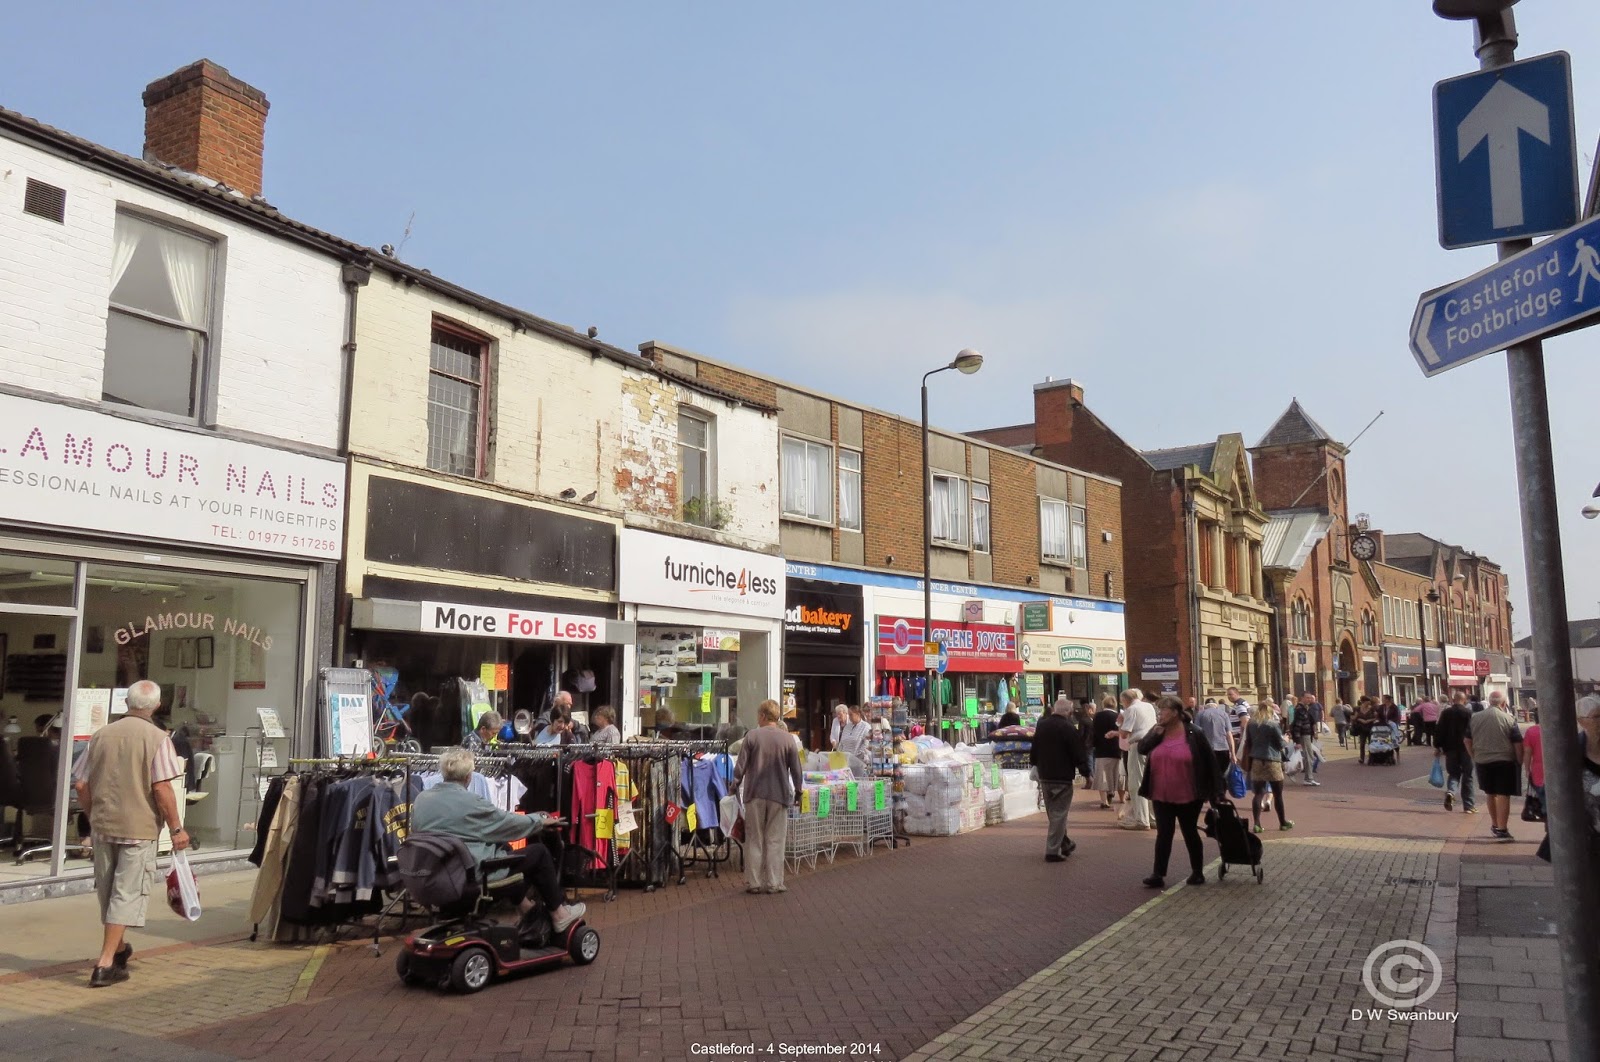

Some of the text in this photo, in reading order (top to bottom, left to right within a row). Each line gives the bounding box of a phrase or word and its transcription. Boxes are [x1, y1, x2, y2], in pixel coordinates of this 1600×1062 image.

[1444, 251, 1560, 323] Castleford
[1446, 286, 1563, 350] Footbridge
[0, 427, 338, 509] AMOUR NAILS
[110, 485, 163, 505] NAILS
[169, 494, 191, 509] AT
[198, 498, 243, 517] YOUR
[250, 506, 338, 532] FINGERTIPS
[211, 524, 336, 551] TEL: 01977 517256
[664, 555, 777, 596] furniche4less
[916, 580, 978, 596] SNCER CENTRE
[113, 612, 274, 652] GLAMOUR NAILS
[435, 606, 598, 640] More For Less
[929, 628, 1007, 651] ARLENE JOYCE
[703, 635, 720, 649] SALE
[341, 697, 365, 708] DAY
